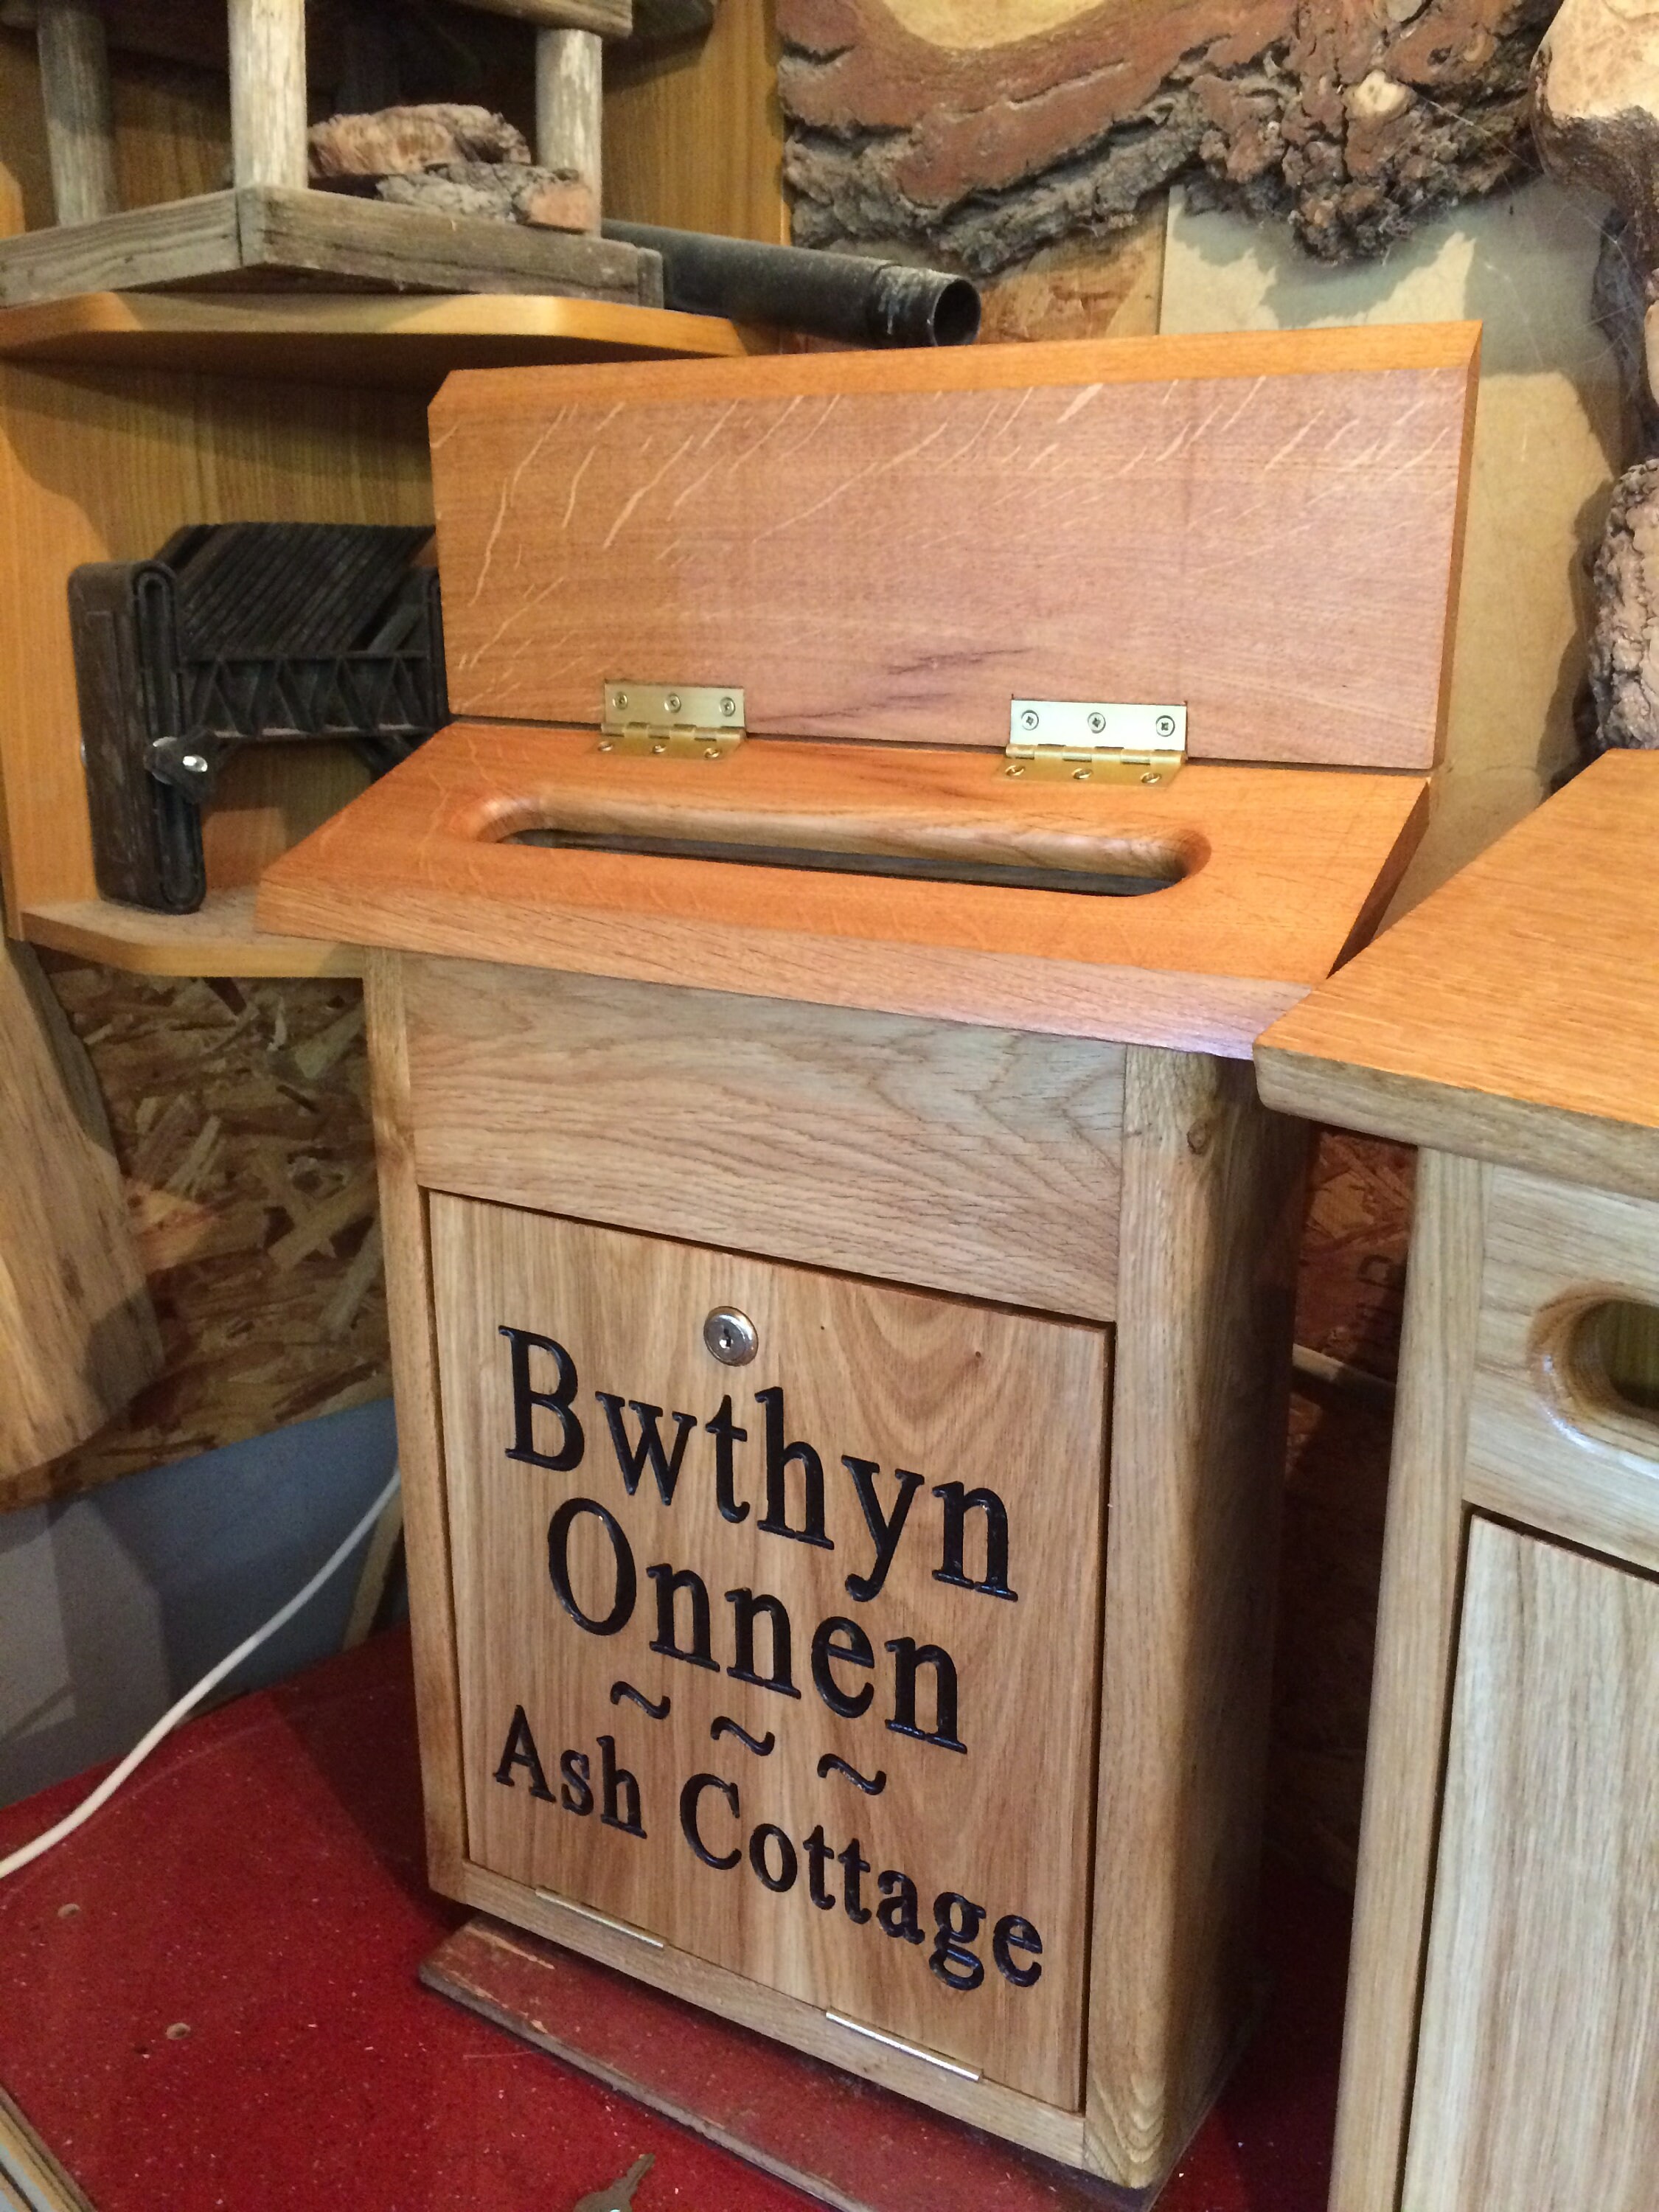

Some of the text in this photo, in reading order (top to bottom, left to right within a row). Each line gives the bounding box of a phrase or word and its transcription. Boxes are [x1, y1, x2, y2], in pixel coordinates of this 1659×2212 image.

[498, 1326, 1018, 1602] Bwthyn
[547, 1498, 967, 1754] Onnen
[493, 1705, 1043, 1991] Ash Cottage
